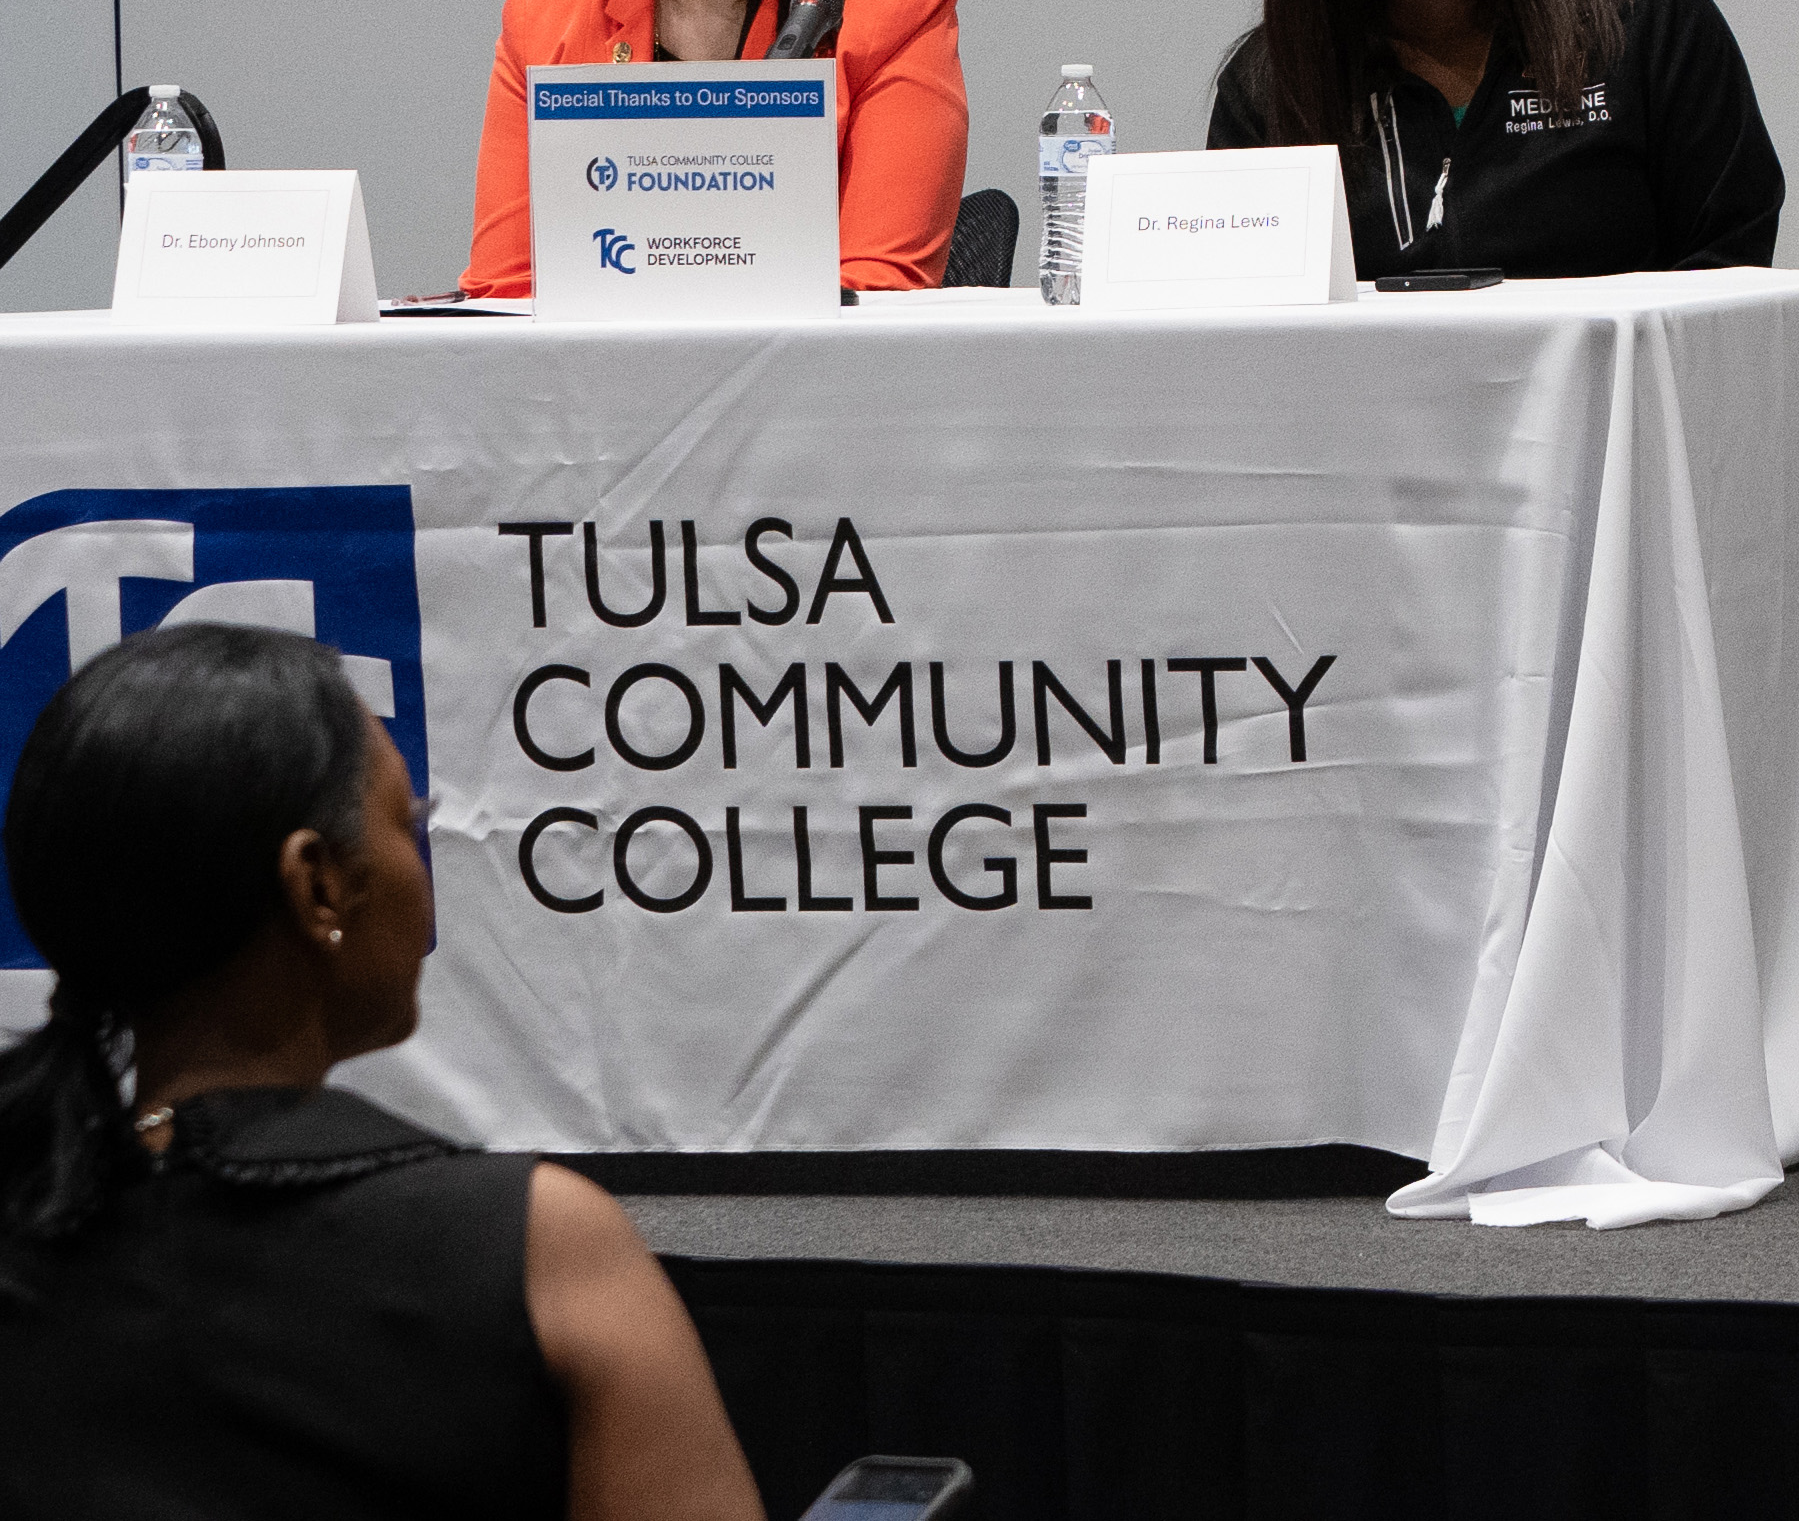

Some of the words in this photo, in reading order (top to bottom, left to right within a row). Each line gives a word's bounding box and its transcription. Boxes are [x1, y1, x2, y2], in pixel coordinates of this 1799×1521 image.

[538, 90, 604, 111] Special
[607, 89, 671, 106] Thanks
[673, 89, 693, 106] to
[696, 88, 731, 105] Our
[734, 88, 819, 108] Sponsors
[1505, 120, 1543, 134] Regina
[1588, 109, 1612, 122] D.O.
[627, 155, 658, 166] TULSA
[660, 155, 727, 166] COMMUNITY
[729, 154, 775, 166] COLLEGE
[627, 171, 775, 192] FOUNDATION
[1138, 216, 1161, 231] Dr.
[1167, 215, 1225, 233] Regina
[1231, 213, 1280, 229] Lewis
[162, 234, 183, 248] Dr.
[188, 234, 238, 252] Ebony
[240, 234, 305, 248] Johnson
[592, 228, 636, 275] TCC
[646, 236, 741, 250] WORKFORCE
[647, 252, 757, 266] DEVELOPMENT
[497, 517, 896, 628] TULSA
[512, 655, 1338, 772] COMMUNITY
[516, 803, 1093, 914] COLLEGE
